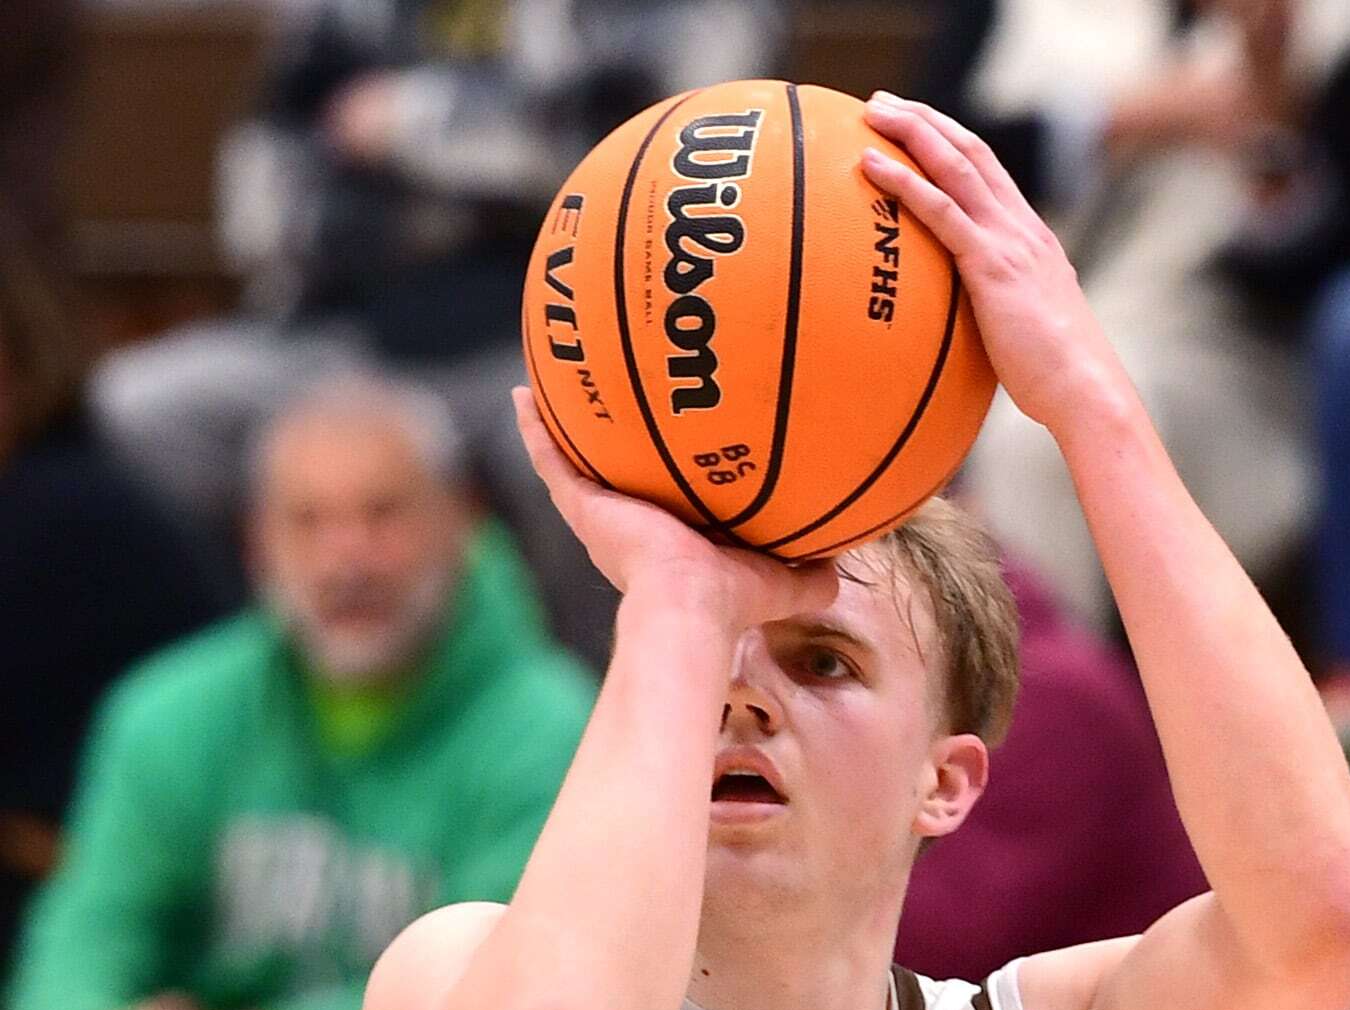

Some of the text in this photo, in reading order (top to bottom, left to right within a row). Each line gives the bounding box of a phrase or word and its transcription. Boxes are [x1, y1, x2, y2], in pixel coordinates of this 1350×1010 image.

[543, 192, 614, 424] EVO NXT
[664, 108, 767, 417] Wilson
[867, 222, 902, 324] NFHS
